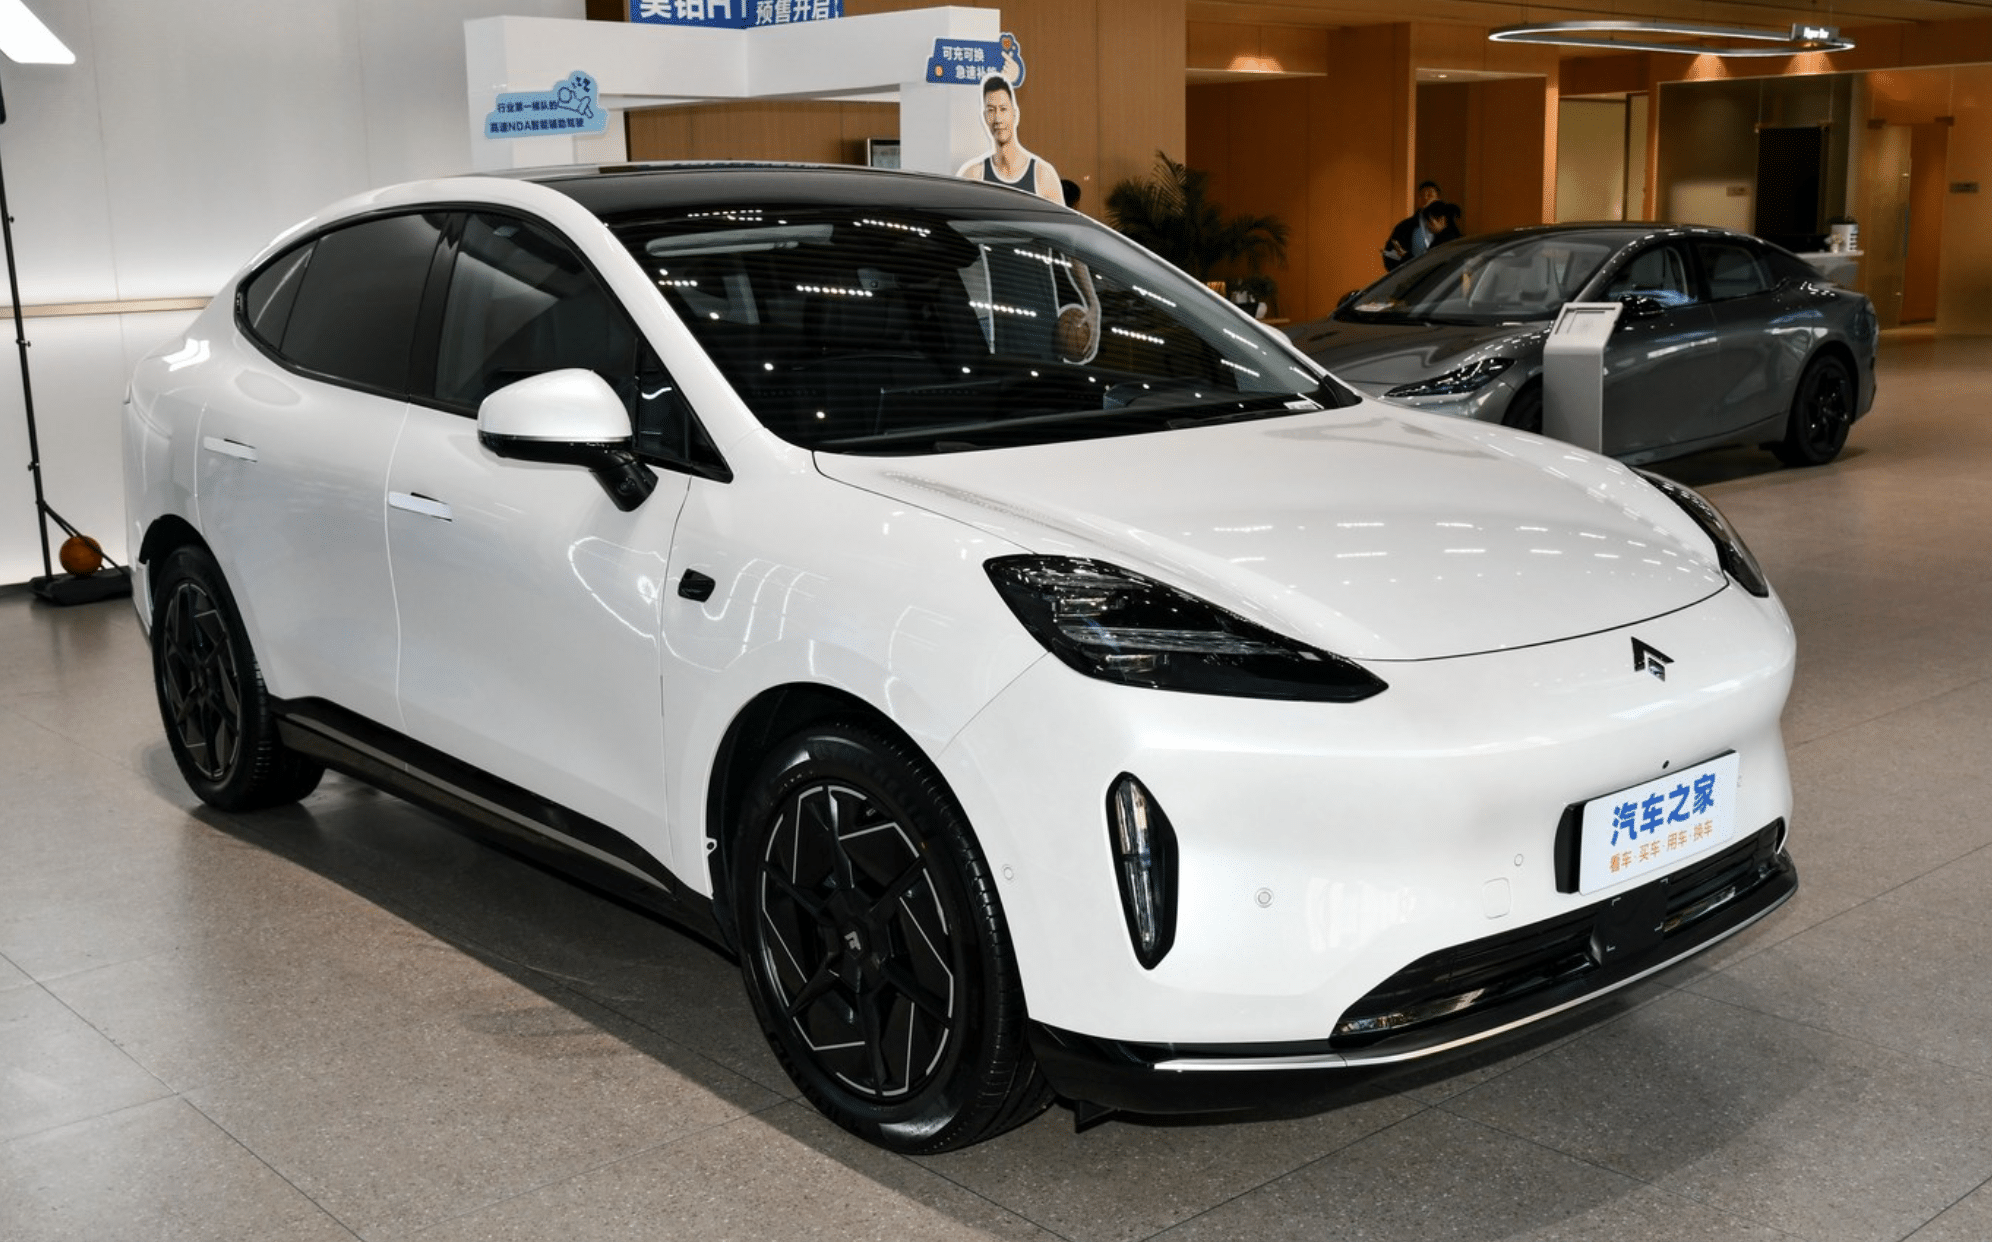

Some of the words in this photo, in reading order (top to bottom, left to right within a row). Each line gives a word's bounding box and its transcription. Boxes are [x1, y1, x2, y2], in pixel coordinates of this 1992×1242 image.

[942, 46, 984, 62] 可充可换
[1611, 773, 1715, 846] 汽车之家
